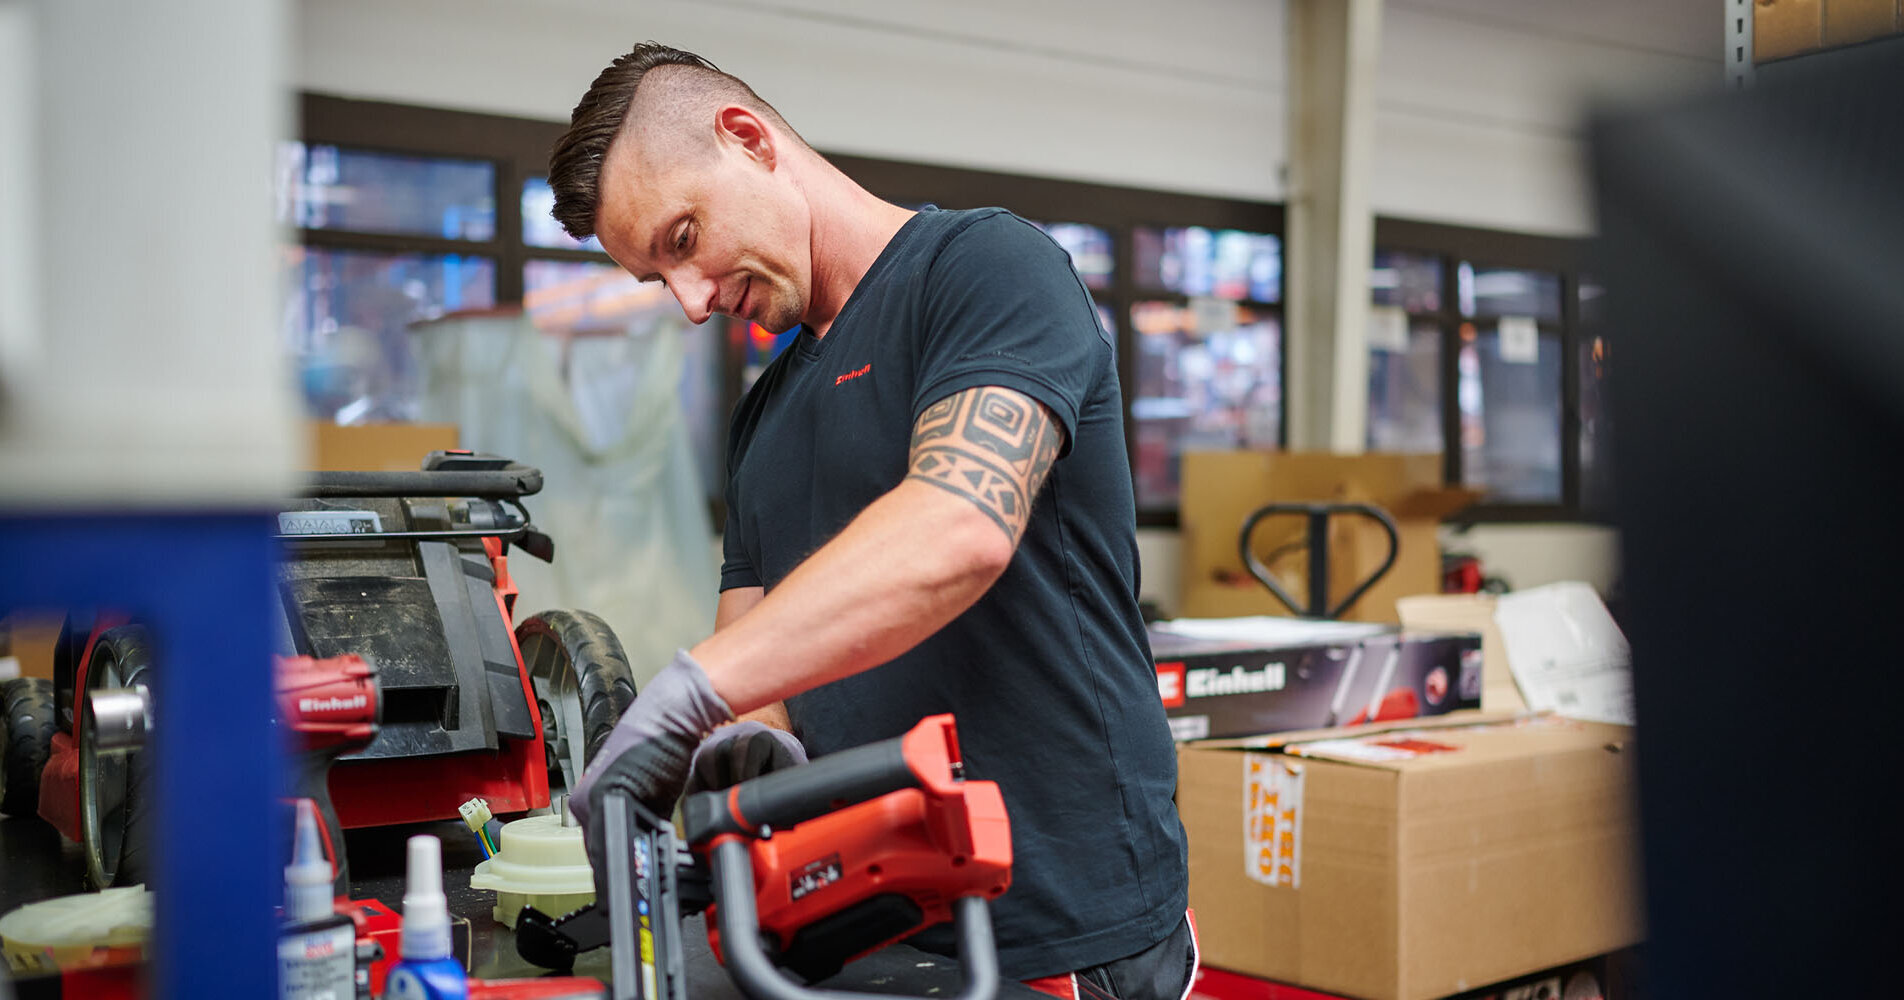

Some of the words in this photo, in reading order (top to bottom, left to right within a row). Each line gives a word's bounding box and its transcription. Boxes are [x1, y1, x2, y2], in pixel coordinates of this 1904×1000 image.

[835, 363, 871, 386] Einhell
[1186, 662, 1285, 698] Einhell
[299, 695, 367, 712] Einhell
